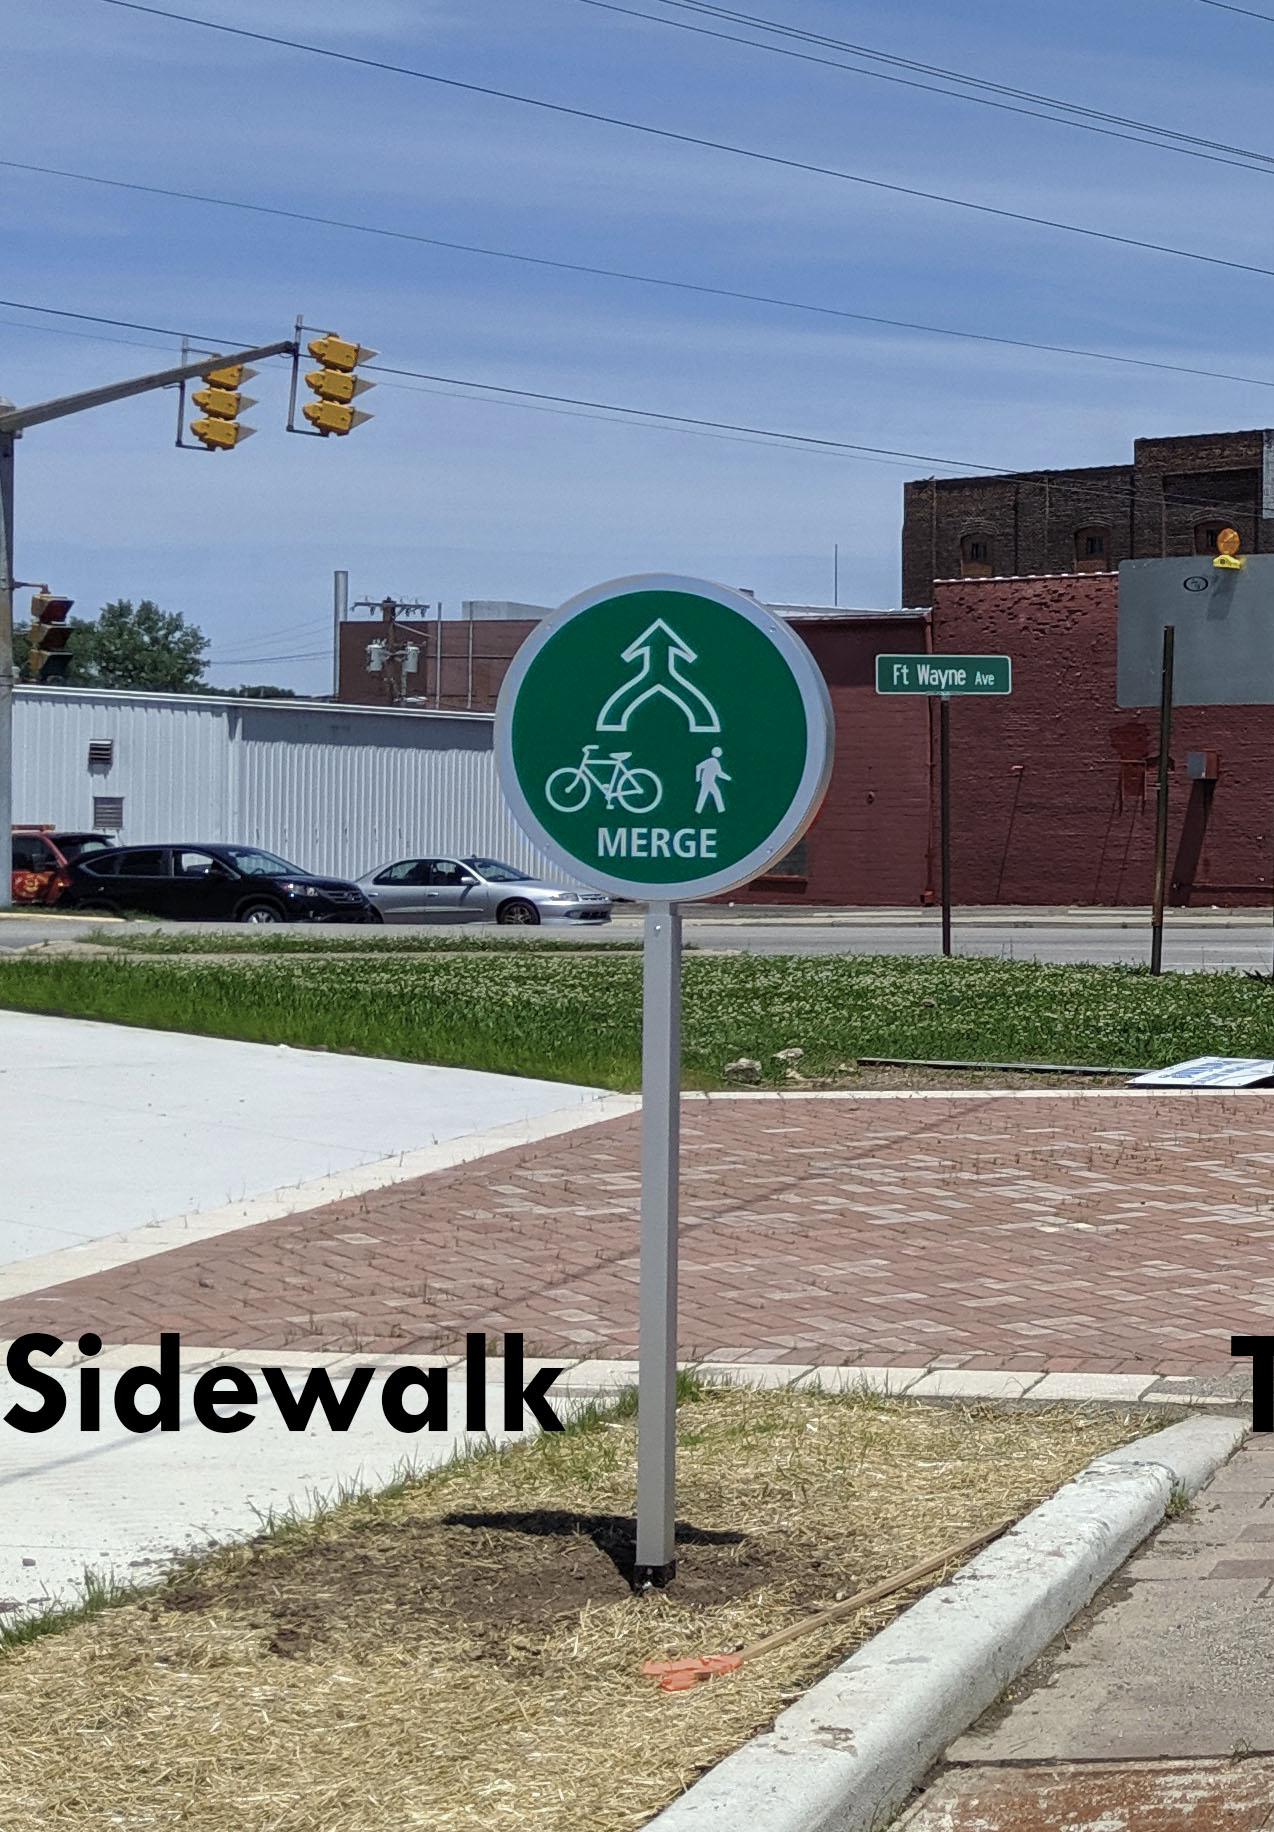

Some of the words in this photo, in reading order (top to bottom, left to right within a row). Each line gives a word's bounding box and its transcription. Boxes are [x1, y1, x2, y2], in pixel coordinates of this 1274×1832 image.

[893, 664, 909, 685] Ft
[917, 664, 966, 689] Wayne
[974, 671, 995, 686] Ave
[597, 827, 717, 858] MERGE
